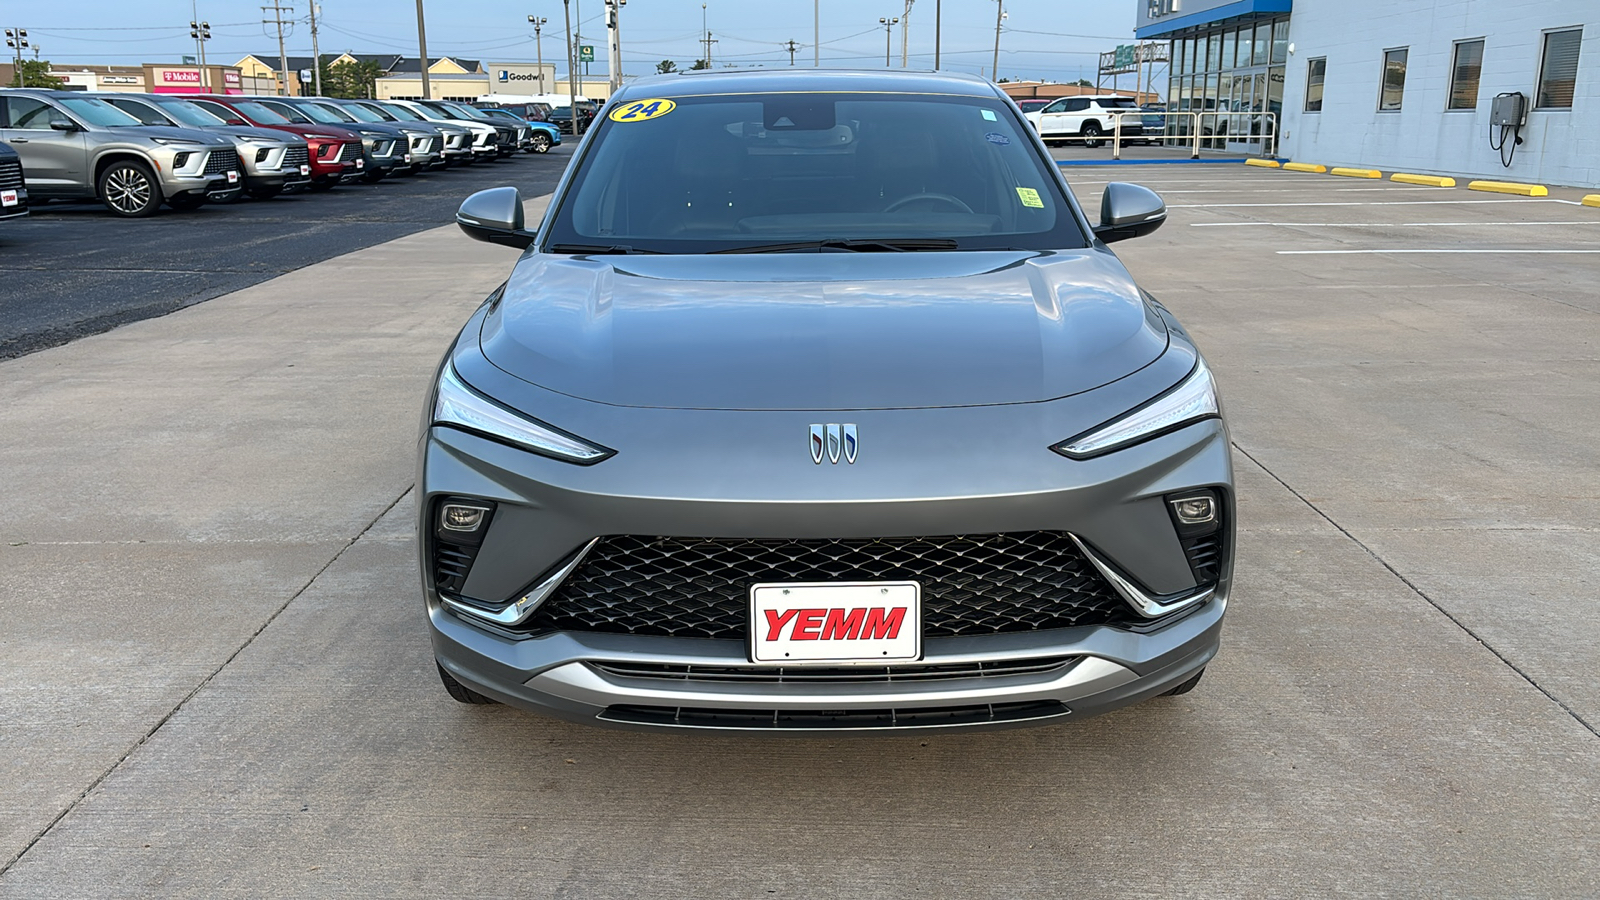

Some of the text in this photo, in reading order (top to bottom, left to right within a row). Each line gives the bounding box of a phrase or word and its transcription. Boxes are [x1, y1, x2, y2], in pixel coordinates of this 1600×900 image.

[509, 73, 545, 81] Goodwl
[621, 102, 662, 119] 24
[763, 607, 908, 641] YEMM
